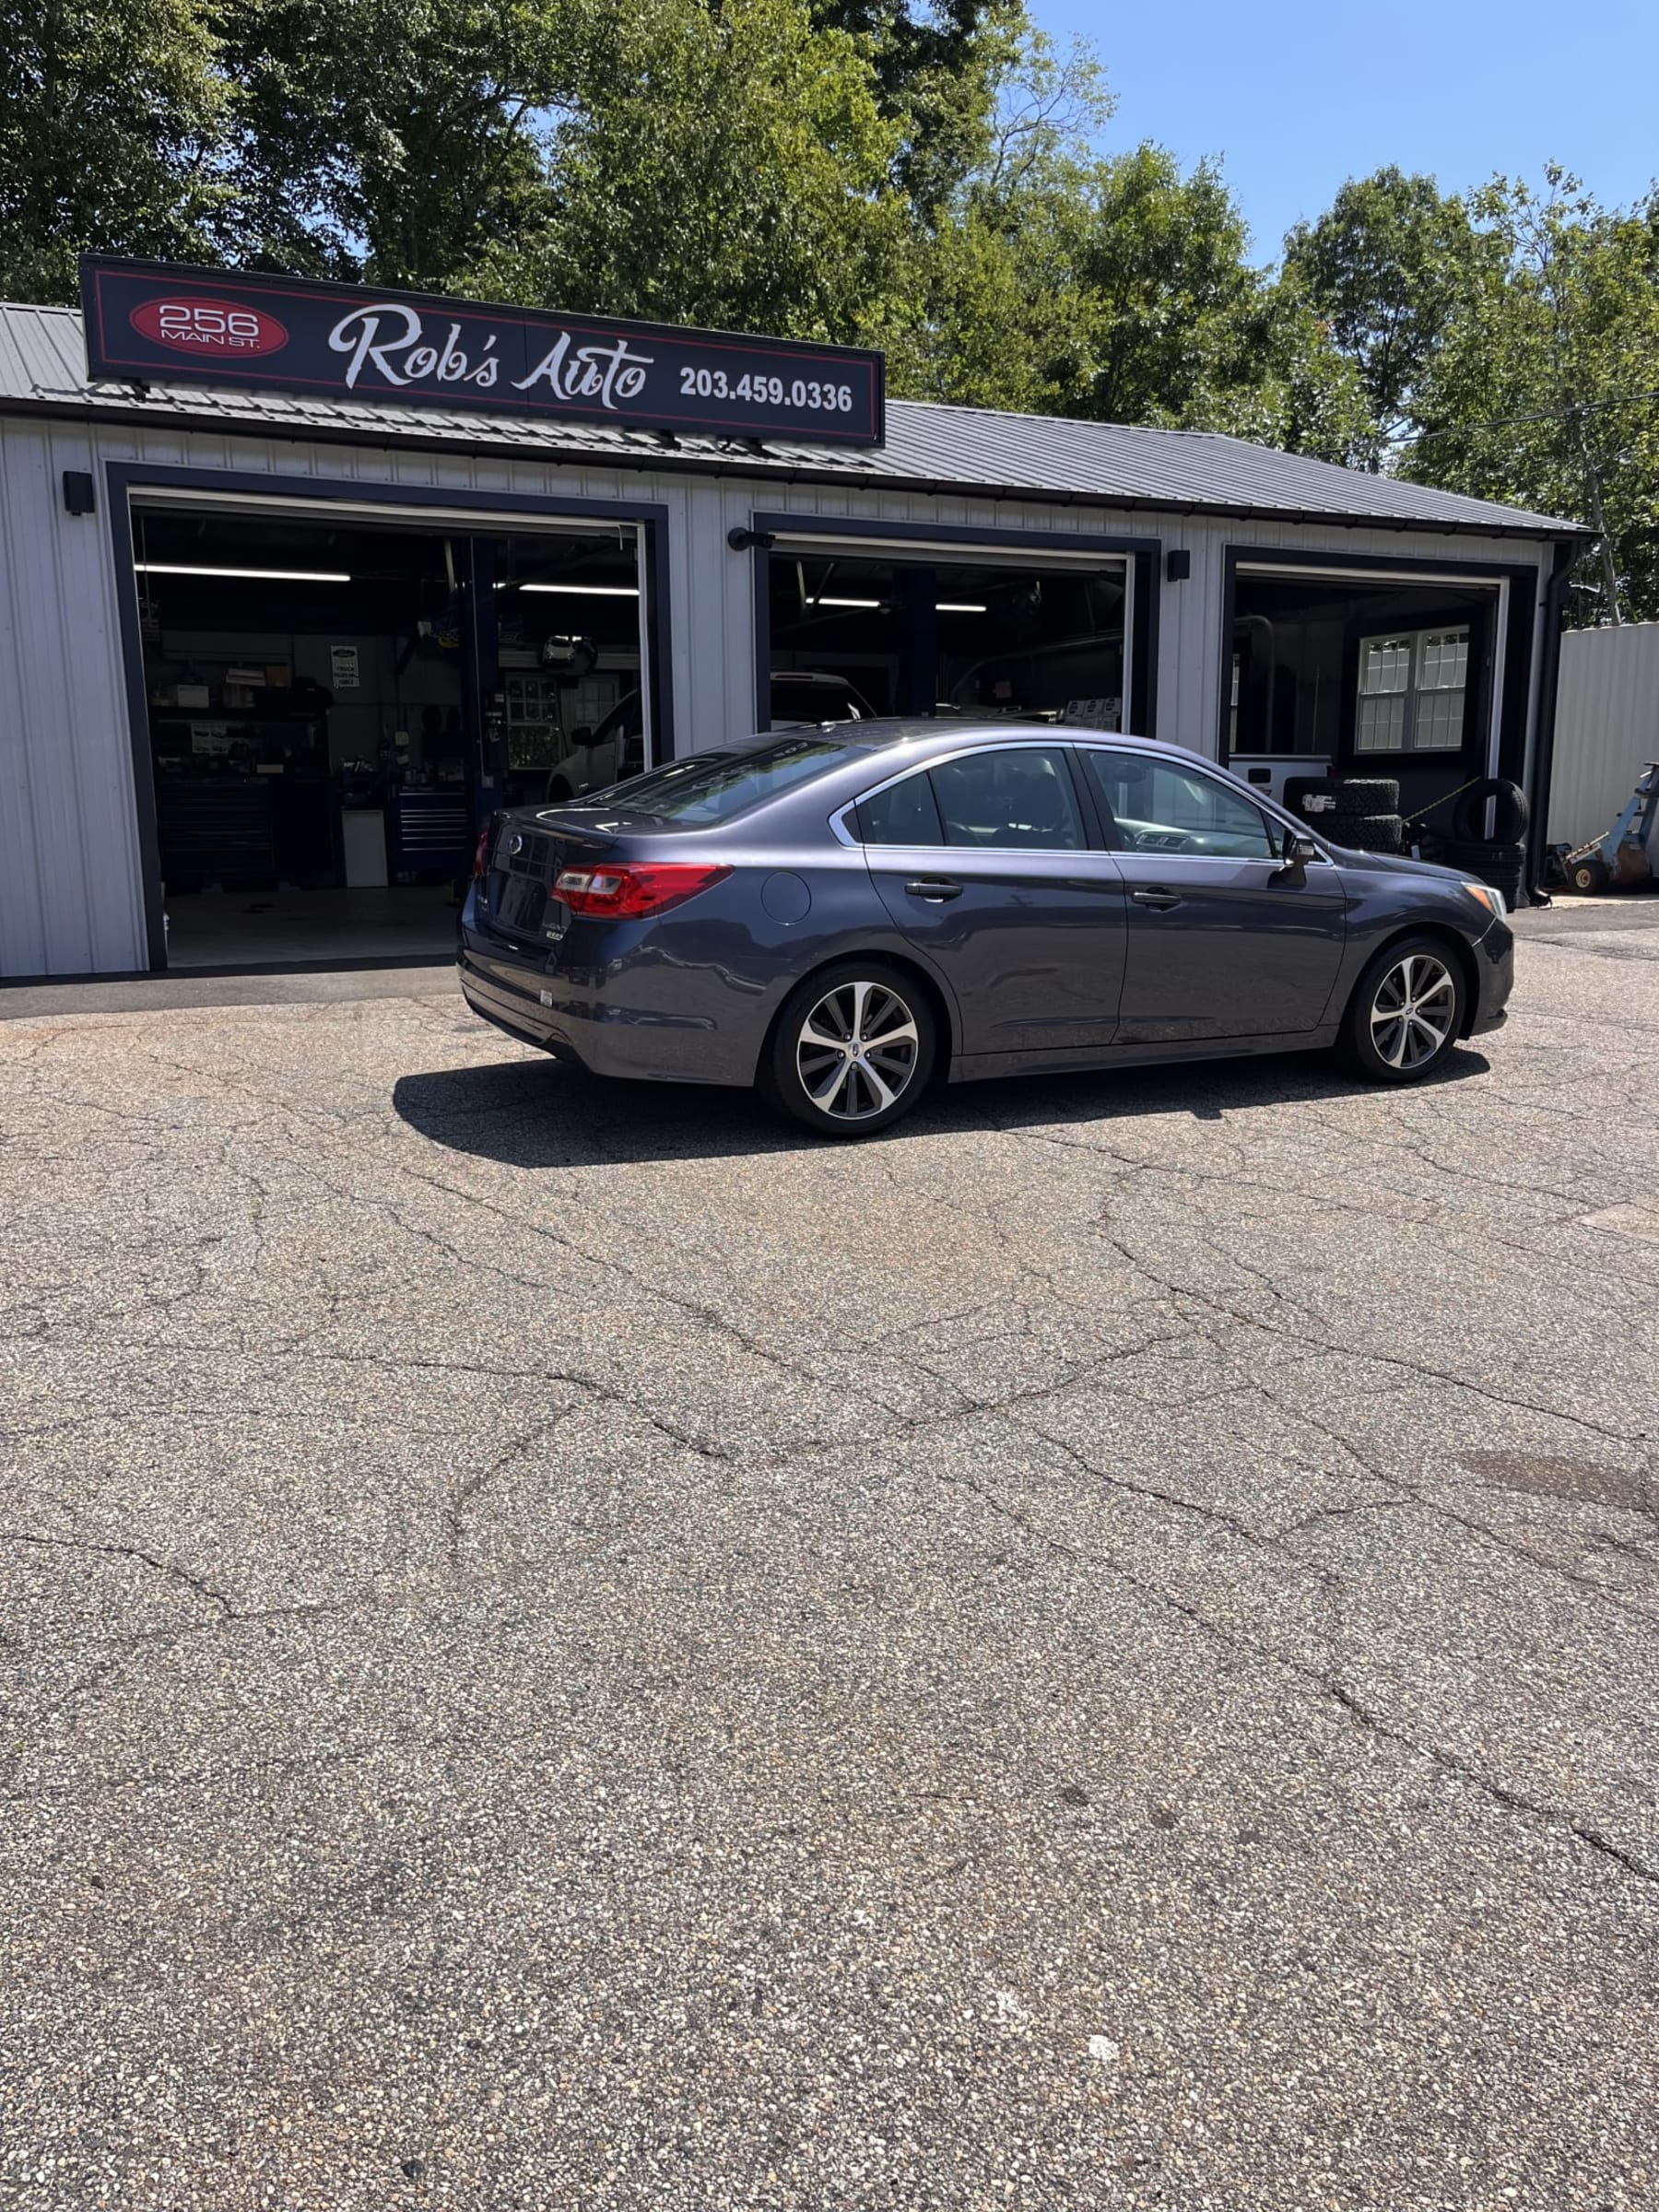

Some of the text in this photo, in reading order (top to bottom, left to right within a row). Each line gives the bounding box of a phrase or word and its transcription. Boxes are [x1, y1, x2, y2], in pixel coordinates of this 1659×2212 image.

[159, 305, 259, 336] 256
[160, 329, 260, 348] MAIN ST.
[328, 304, 654, 409] Rob's Auto
[680, 367, 853, 412] 203.459.0336
